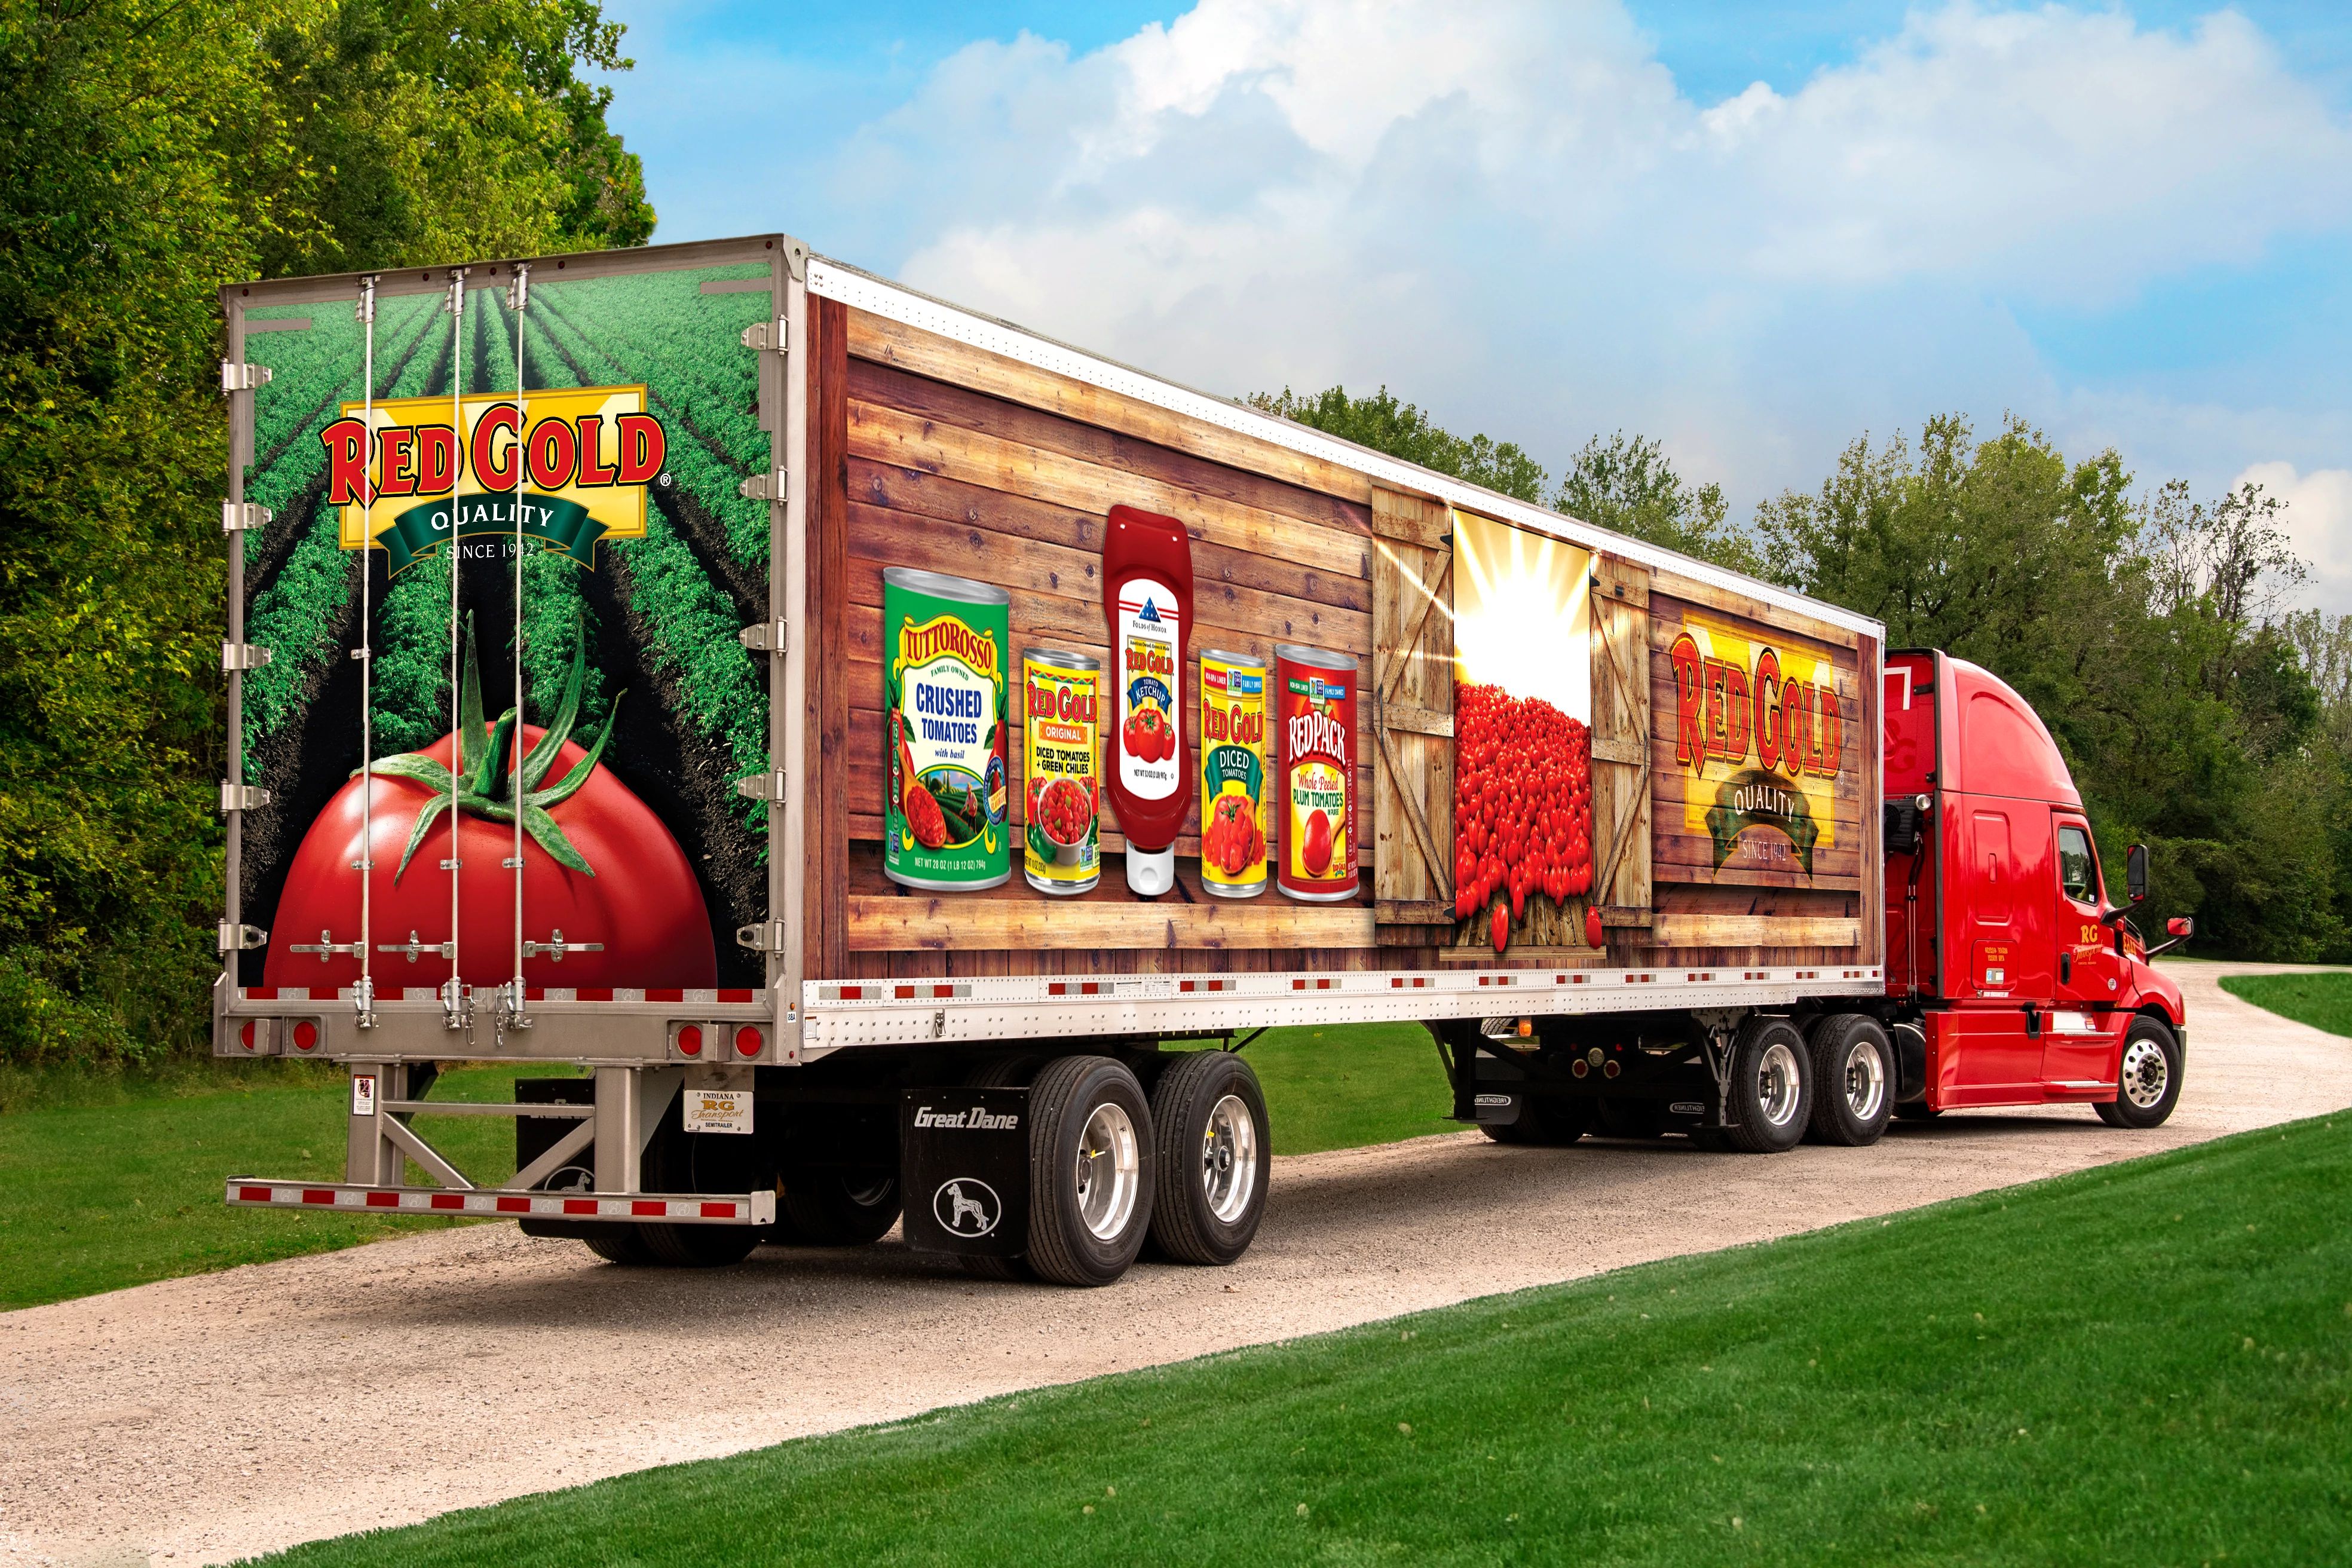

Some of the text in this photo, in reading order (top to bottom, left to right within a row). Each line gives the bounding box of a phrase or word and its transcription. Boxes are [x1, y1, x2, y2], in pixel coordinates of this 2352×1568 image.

[318, 402, 667, 509] RED GOLD
[430, 504, 555, 531] QUALITY
[446, 544, 495, 559] SINCE
[1146, 623, 1151, 632] of
[905, 621, 992, 669] TUTTOROSSO
[1125, 648, 1174, 675] RED GOLD
[930, 664, 969, 681] FAMILY OWNED
[1217, 675, 1226, 685] LINER
[1143, 679, 1158, 687] TOMATO
[1242, 680, 1253, 688] FAMILY
[1300, 683, 1309, 691] LINER
[916, 682, 982, 718] CRUSHED
[1027, 681, 1097, 723] RED GOLD
[1135, 685, 1165, 702] KETCHUP
[1669, 632, 1842, 781] RED GOLD
[921, 718, 977, 744] TOMATOES
[1203, 699, 1263, 745] RED GOLD
[1045, 725, 1082, 741] ORIGINAL
[935, 748, 965, 759] with basil
[1036, 746, 1090, 762] DICED TOMATOES
[1219, 749, 1249, 769] DICED
[1042, 760, 1064, 773] GREEN
[1065, 762, 1089, 774] CHILIES
[1222, 768, 1247, 780] TOMATOES
[1297, 771, 1340, 791] Whole Peeled
[1293, 788, 1343, 807] PLUM TOMATOES
[1734, 785, 1795, 824] QUALITY
[1742, 840, 1786, 861] SINCE 1942
[915, 857, 923, 868] NET
[924, 858, 932, 868] WT
[933, 859, 939, 869] 28
[940, 860, 946, 870] OZ
[947, 860, 952, 872] (1
[954, 860, 960, 870] LB
[961, 860, 966, 870] 12
[2081, 924, 2098, 943] RG
[691, 1109, 744, 1120] Transport
[700, 1100, 735, 1111] RG
[914, 1107, 1019, 1129] Great Dane
